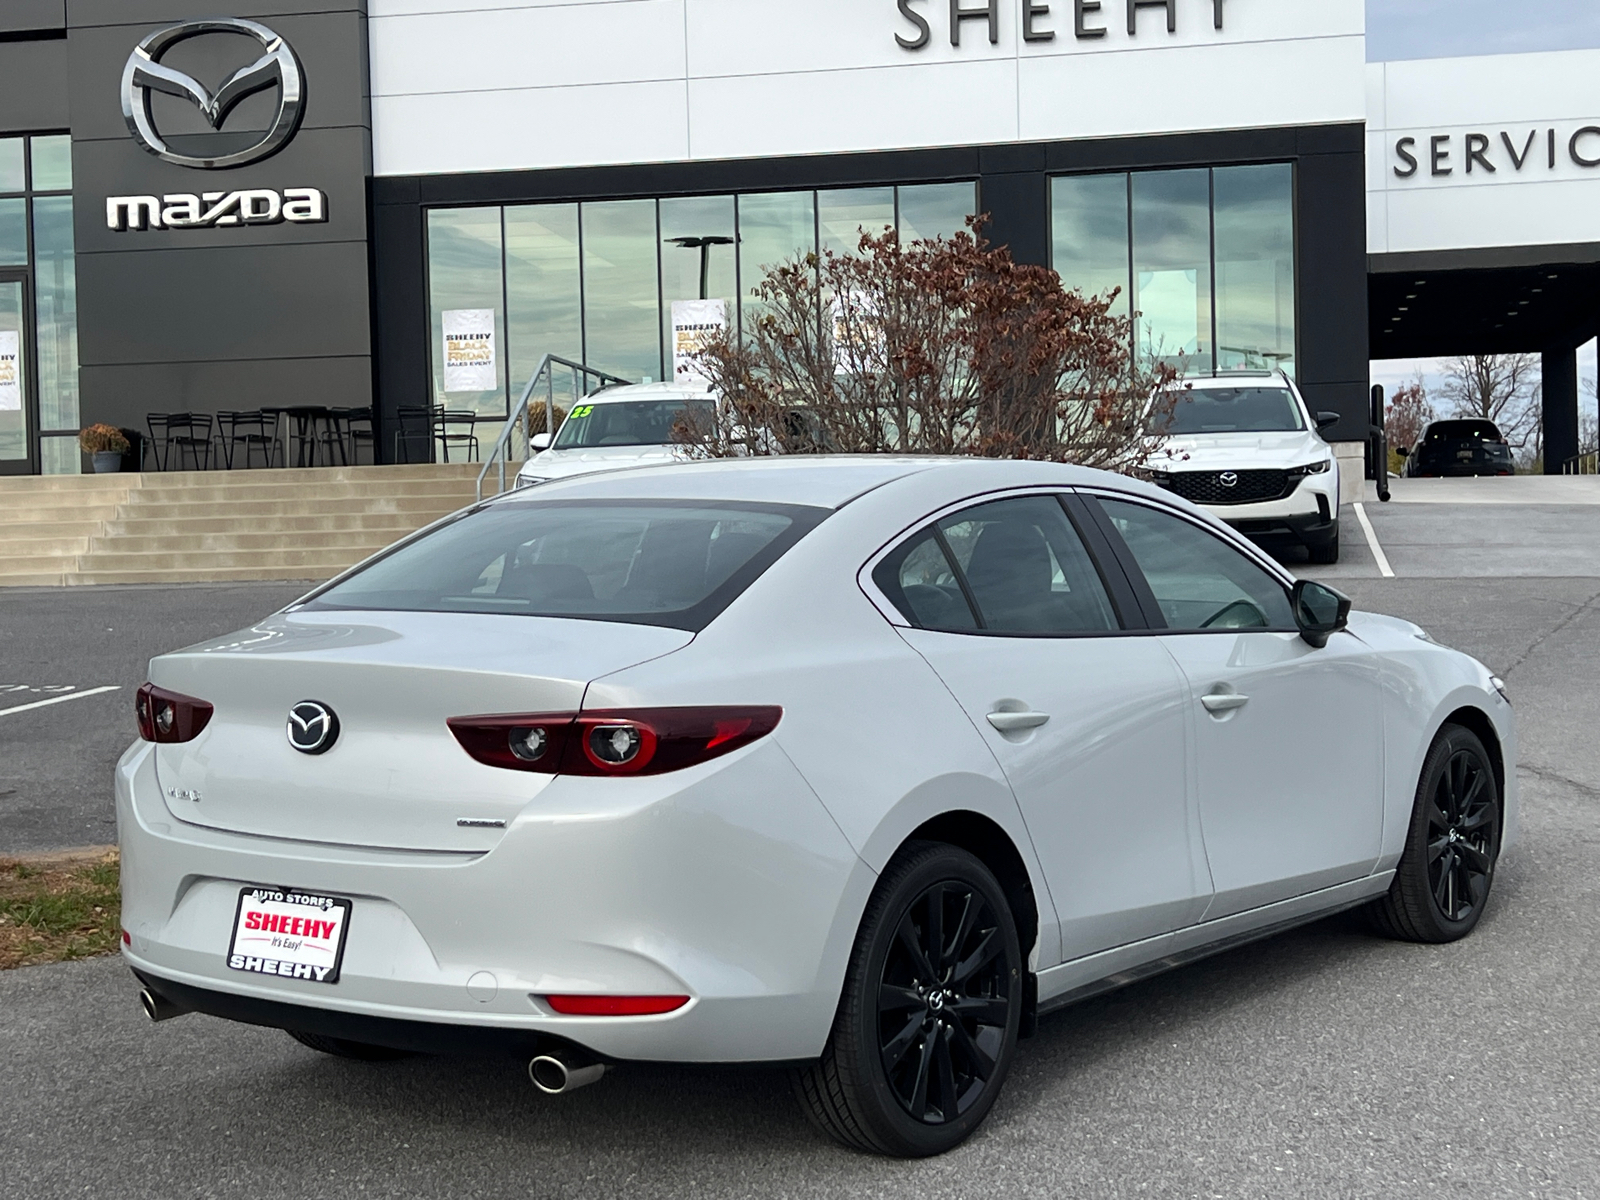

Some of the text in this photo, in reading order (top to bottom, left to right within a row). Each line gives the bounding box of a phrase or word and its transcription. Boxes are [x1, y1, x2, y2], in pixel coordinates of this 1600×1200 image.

[1393, 126, 1600, 177] SERVIC
[446, 333, 491, 341] SHEEHY
[447, 341, 489, 350] BLACK
[447, 350, 491, 361] FRIDAY
[570, 406, 594, 418] 25
[251, 889, 283, 901] AUTO
[244, 911, 336, 940] SHEEHY
[271, 936, 303, 952] It's Easy!
[229, 954, 331, 981] SHEEHY
